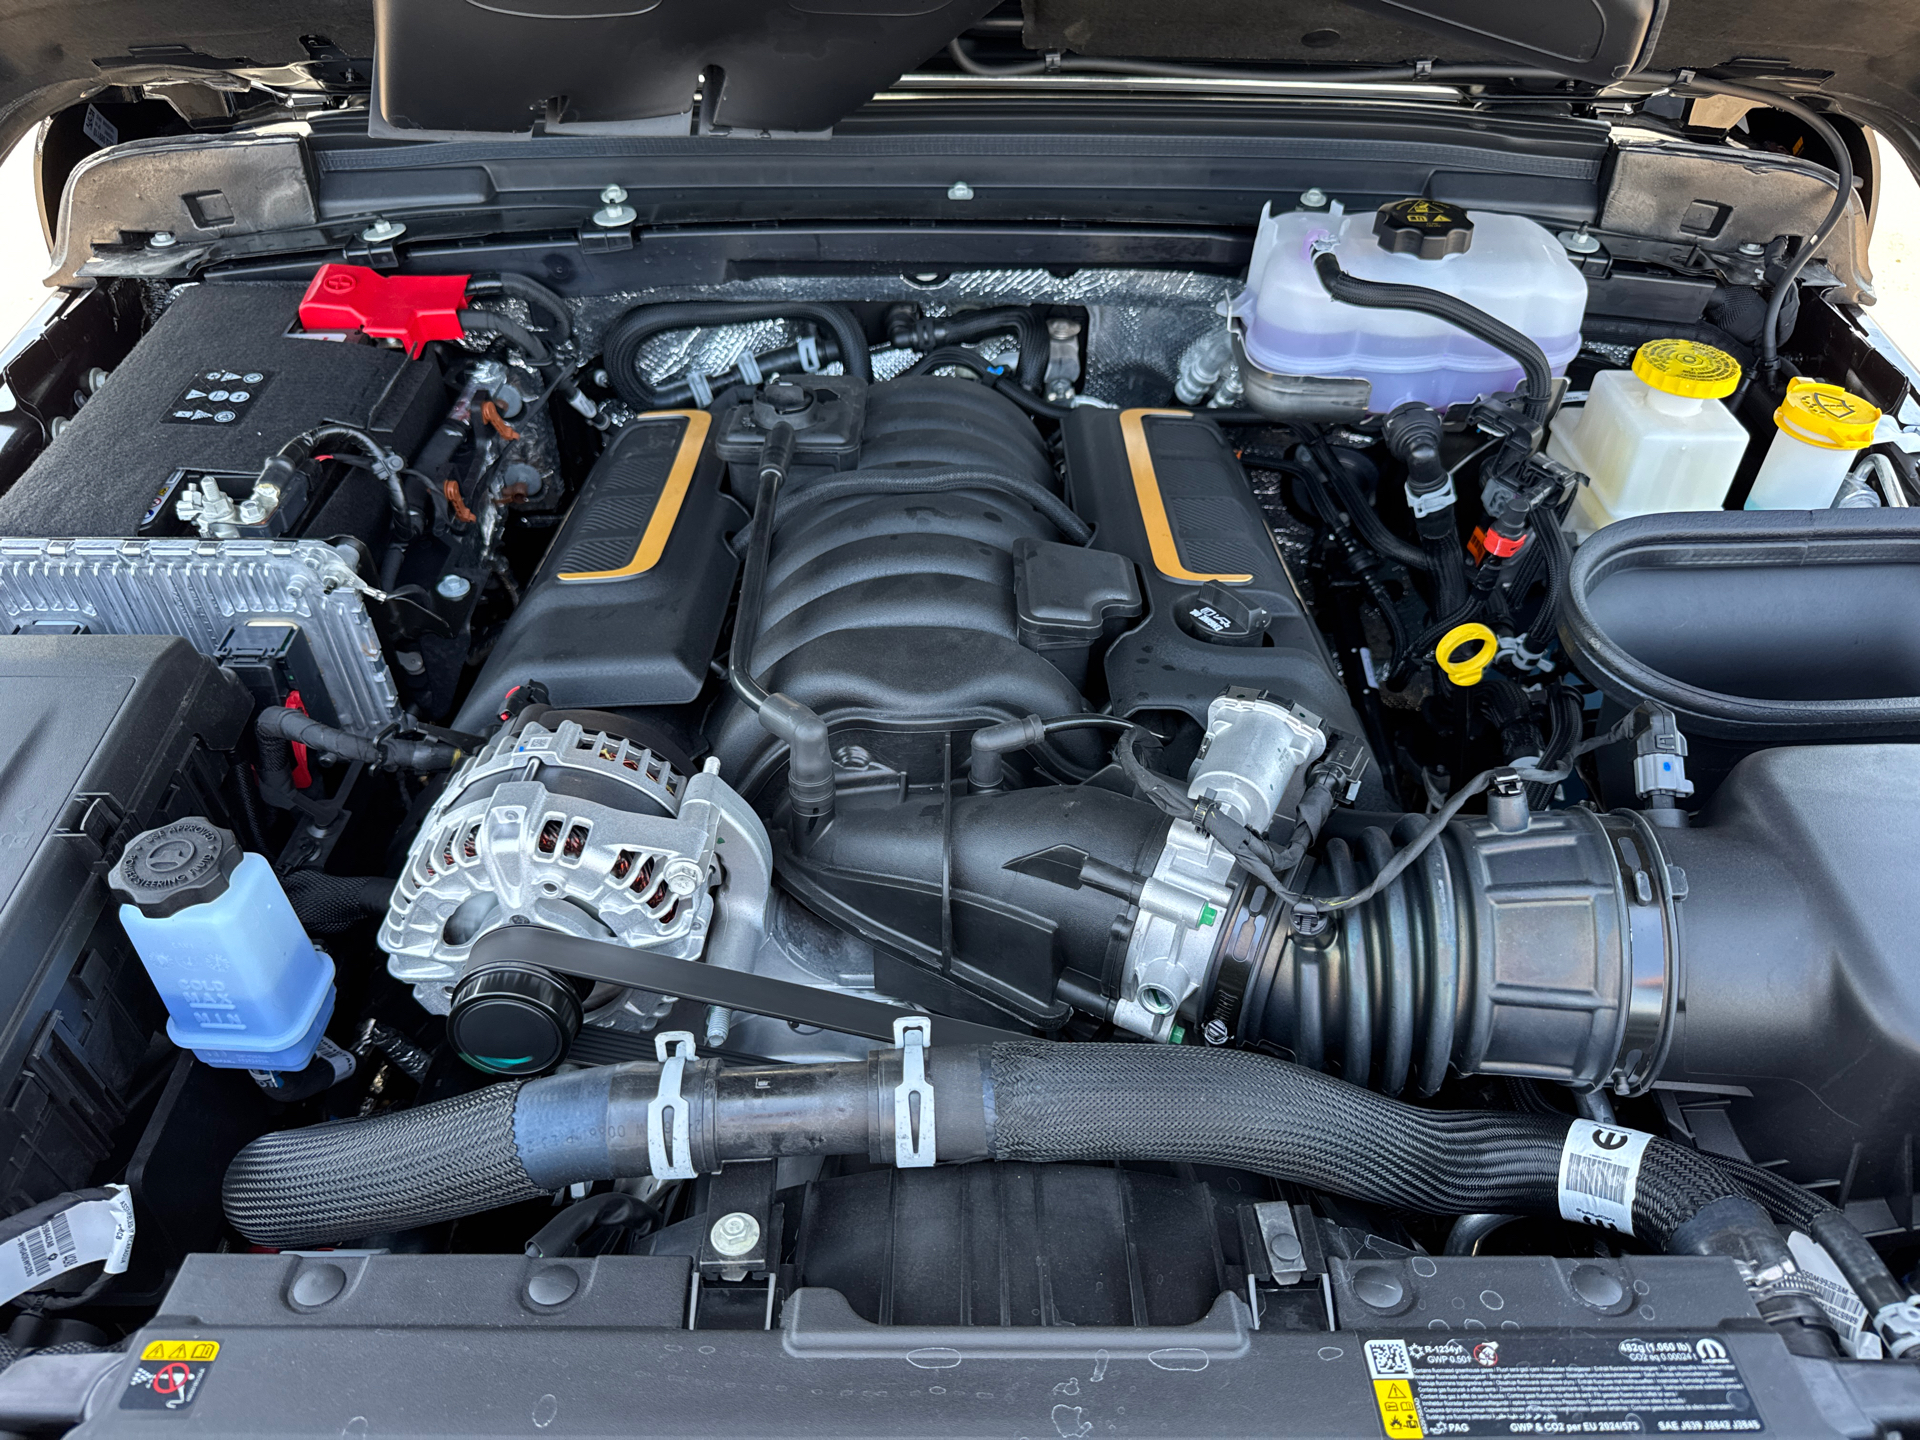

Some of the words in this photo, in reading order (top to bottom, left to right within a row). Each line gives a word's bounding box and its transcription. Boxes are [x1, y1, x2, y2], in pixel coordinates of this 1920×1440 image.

[145, 830, 166, 843] USE
[169, 824, 216, 842] APPROVED
[125, 854, 138, 882] POWER
[134, 875, 188, 888] STEERING
[188, 854, 214, 876] FLUID
[178, 979, 225, 992] COLD
[182, 992, 232, 1004] MAX
[194, 1012, 242, 1024] MIN
[1424, 1345, 1462, 1354] R-1234yf
[1620, 1343, 1646, 1352] 482g
[1646, 1342, 1676, 1352] (1.060
[1676, 1342, 1692, 1352] lb)
[1426, 1356, 1448, 1364] GWP
[1450, 1356, 1472, 1364] 0.501
[1629, 1352, 1648, 1362] CO2
[1449, 1423, 1470, 1432] PAG
[1510, 1422, 1534, 1432] GWP
[1544, 1422, 1564, 1432] CO2
[1583, 1422, 1597, 1431] EU
[1658, 1421, 1680, 1430] SAE
